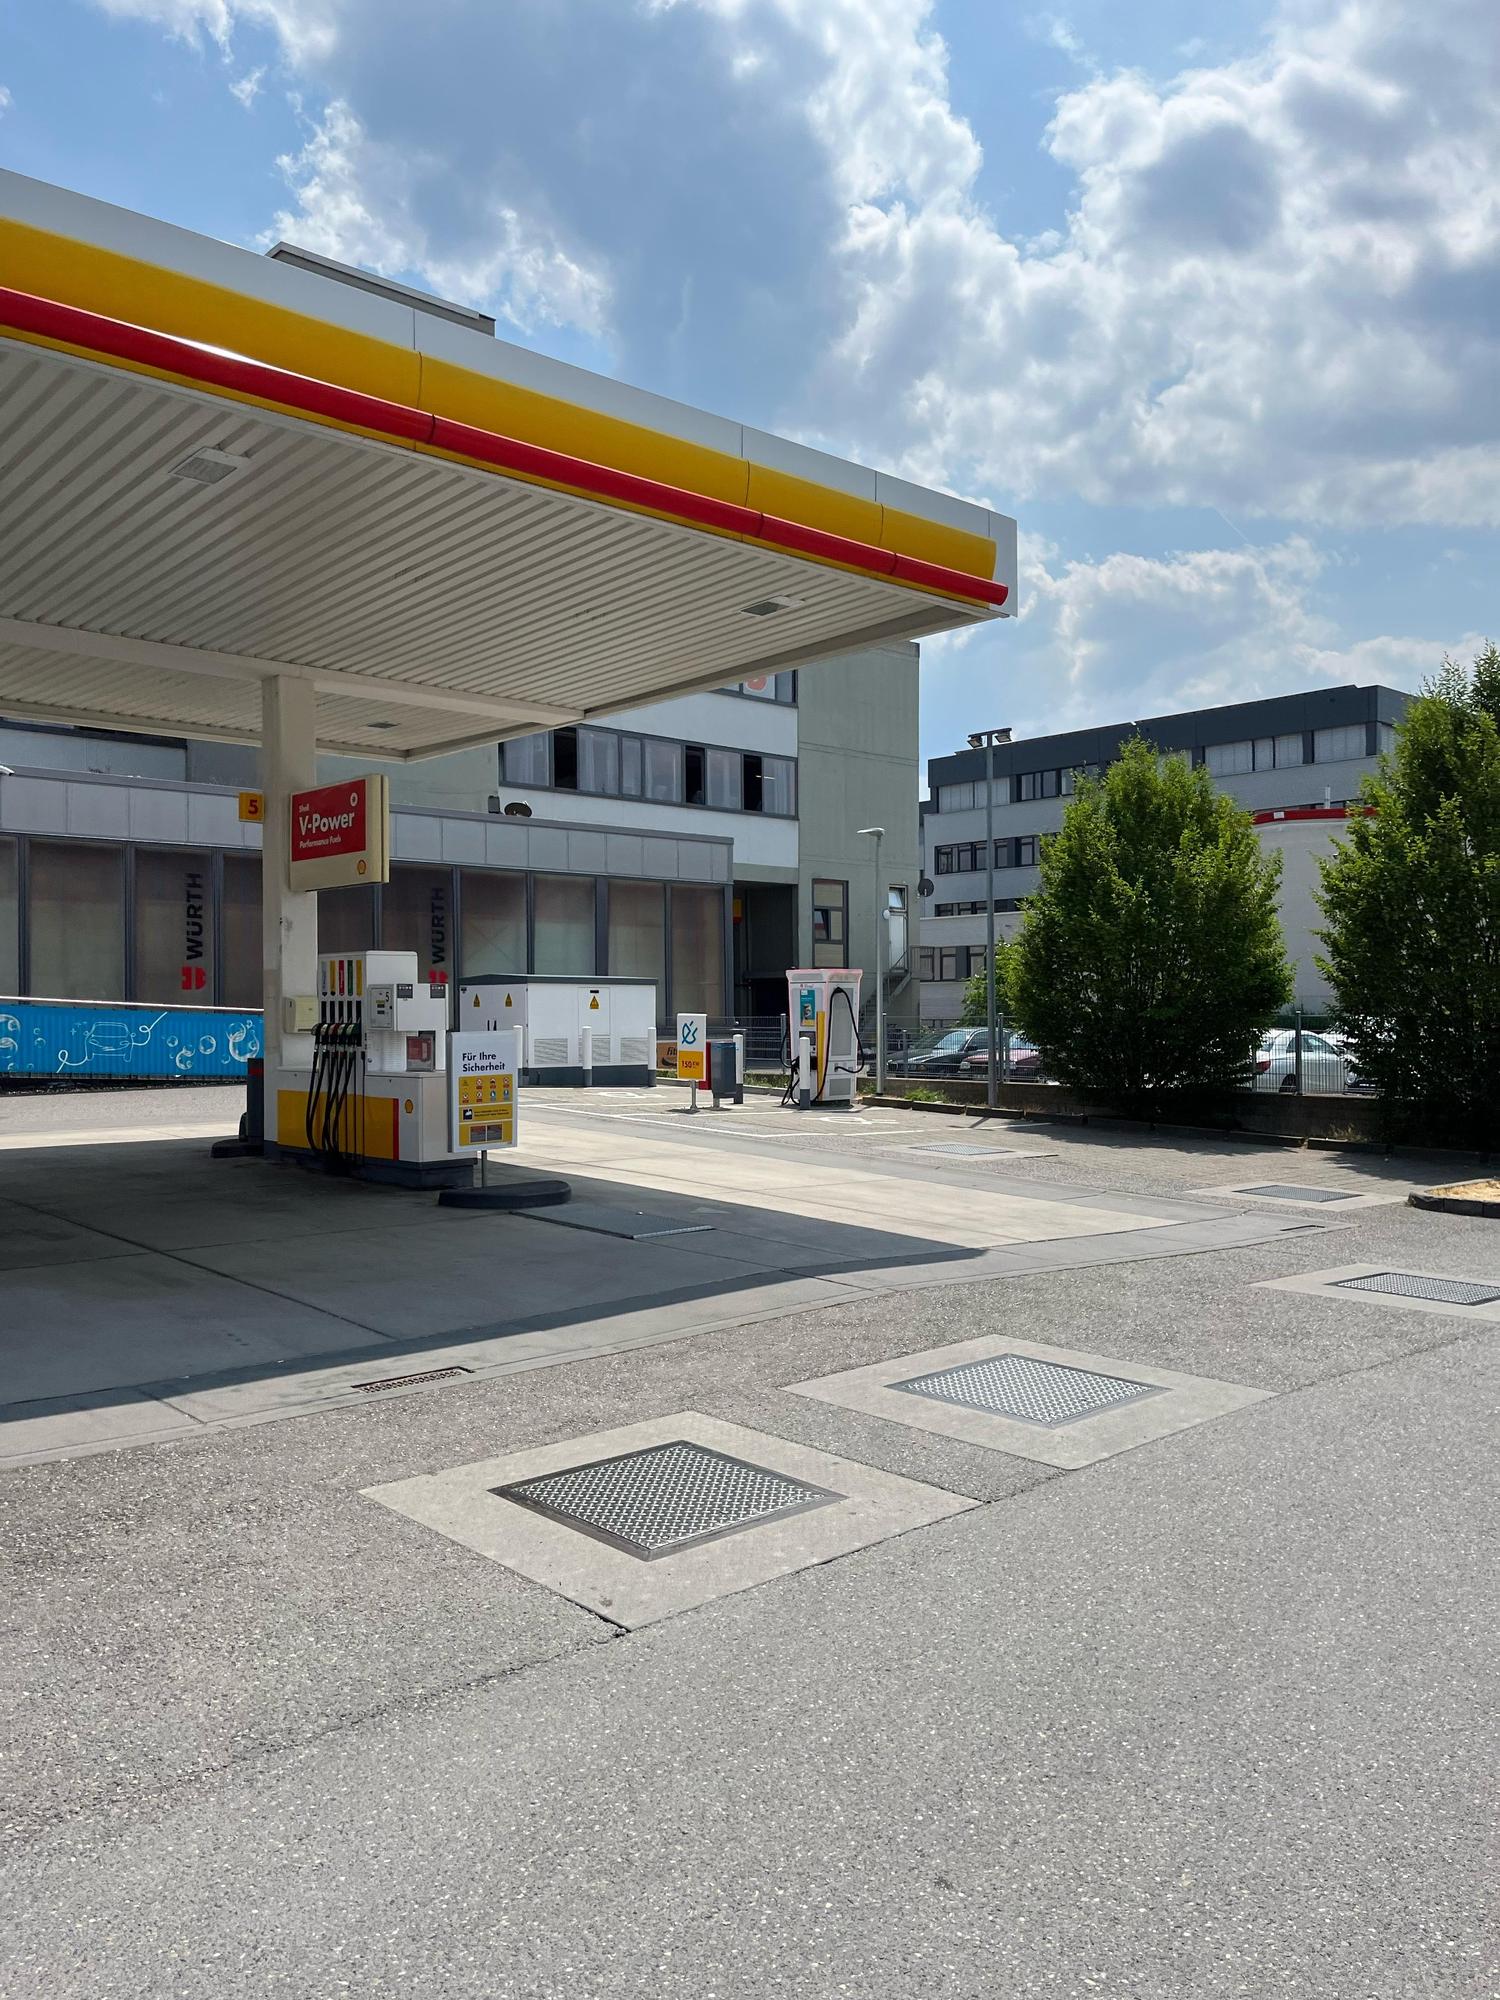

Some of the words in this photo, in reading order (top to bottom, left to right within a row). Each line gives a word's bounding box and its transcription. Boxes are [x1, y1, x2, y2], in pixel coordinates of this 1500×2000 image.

[248, 800, 258, 814] 5
[299, 812, 355, 836] V-Power
[299, 838, 329, 849] Performance
[329, 834, 342, 845] Fuels
[185, 872, 204, 960] WÜRTH
[385, 992, 390, 1002] 5
[462, 1052, 477, 1062] Für
[479, 1051, 497, 1061] Ihre
[462, 1061, 506, 1073] Sicherheit
